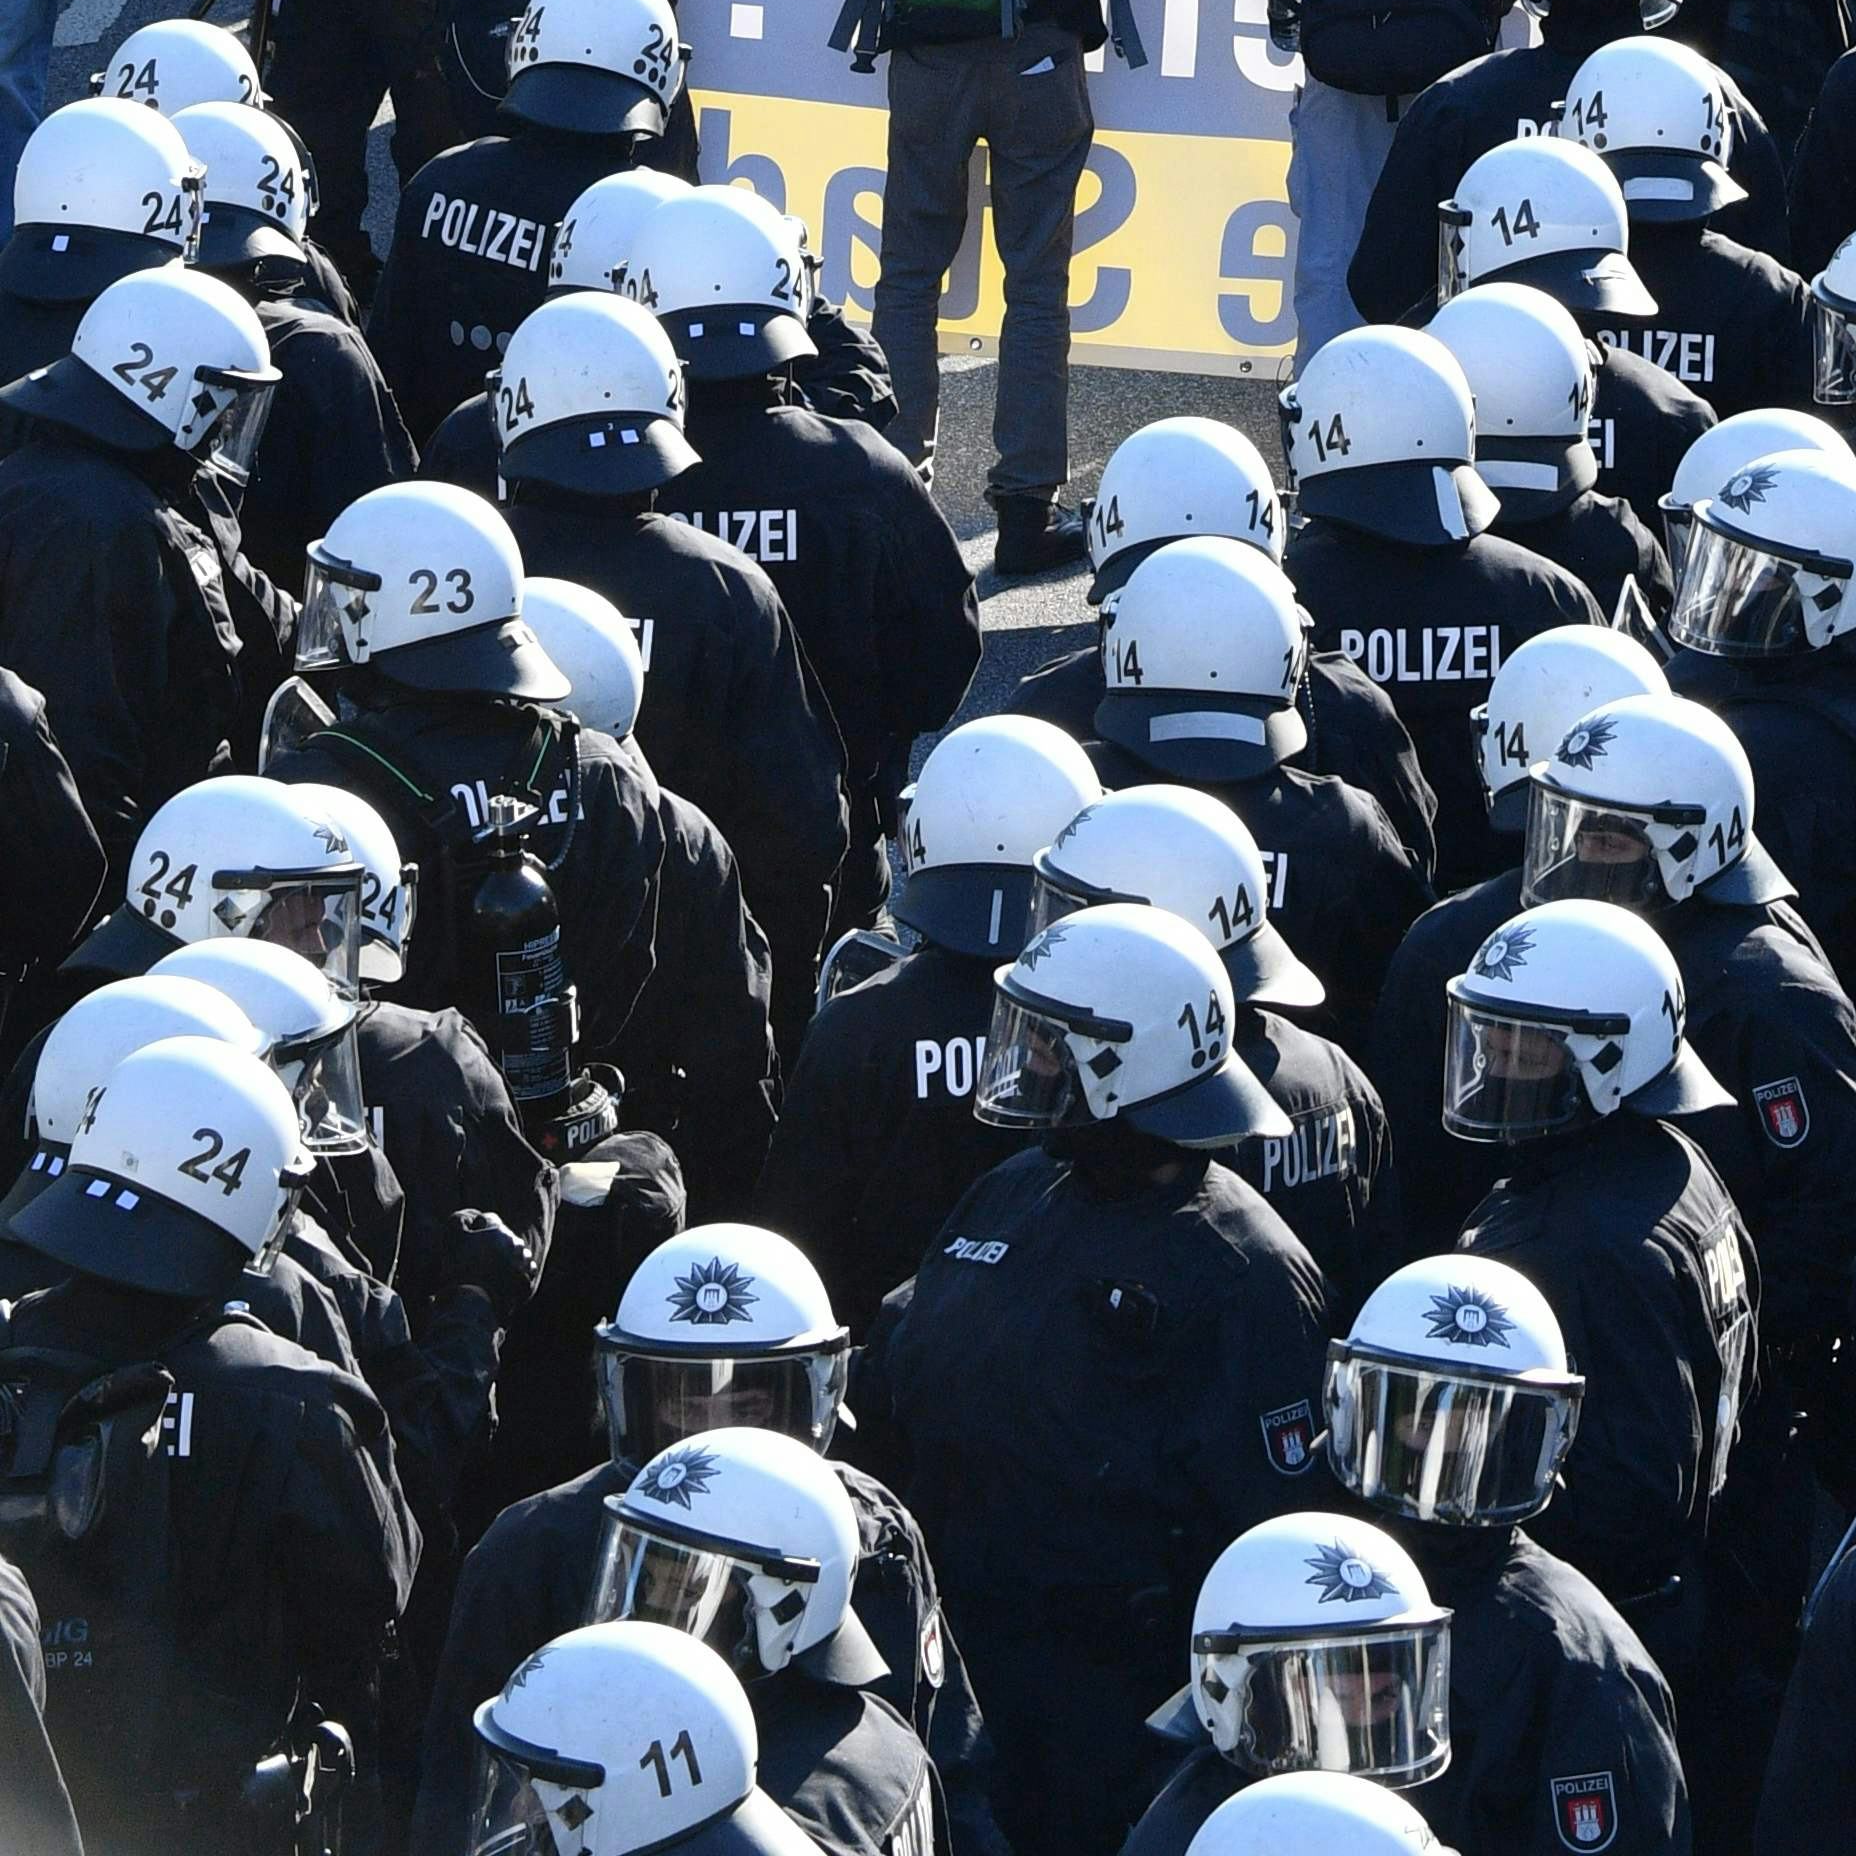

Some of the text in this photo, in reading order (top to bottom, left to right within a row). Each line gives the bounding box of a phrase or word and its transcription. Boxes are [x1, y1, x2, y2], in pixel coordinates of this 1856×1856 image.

[648, 24, 674, 70] 24
[118, 59, 158, 96] 24
[1572, 91, 1609, 132] 14
[257, 156, 294, 201] 24
[142, 193, 183, 235] 24
[420, 193, 546, 272] POLIZEI
[1491, 200, 1541, 246] 14
[772, 258, 803, 300] 24
[114, 342, 176, 402] 24
[501, 387, 534, 430] 24
[1308, 414, 1350, 462] 14
[1095, 496, 1123, 547] 14
[1245, 490, 1276, 539] 14
[409, 569, 475, 615] 23
[1112, 640, 1142, 685] 14
[1340, 627, 1502, 682] POLIZEI
[1495, 720, 1529, 770] 14
[1710, 806, 1746, 866] 14
[138, 850, 198, 910] 24
[360, 873, 400, 930] 24
[1209, 883, 1254, 942] 14
[1178, 991, 1225, 1048] 14
[177, 1128, 251, 1195] 24
[1264, 1108, 1356, 1192] POLIZEI
[944, 1237, 1009, 1264] POLIZEI
[639, 1731, 703, 1798] 11
[1555, 1776, 1611, 1797] POLIZEI
